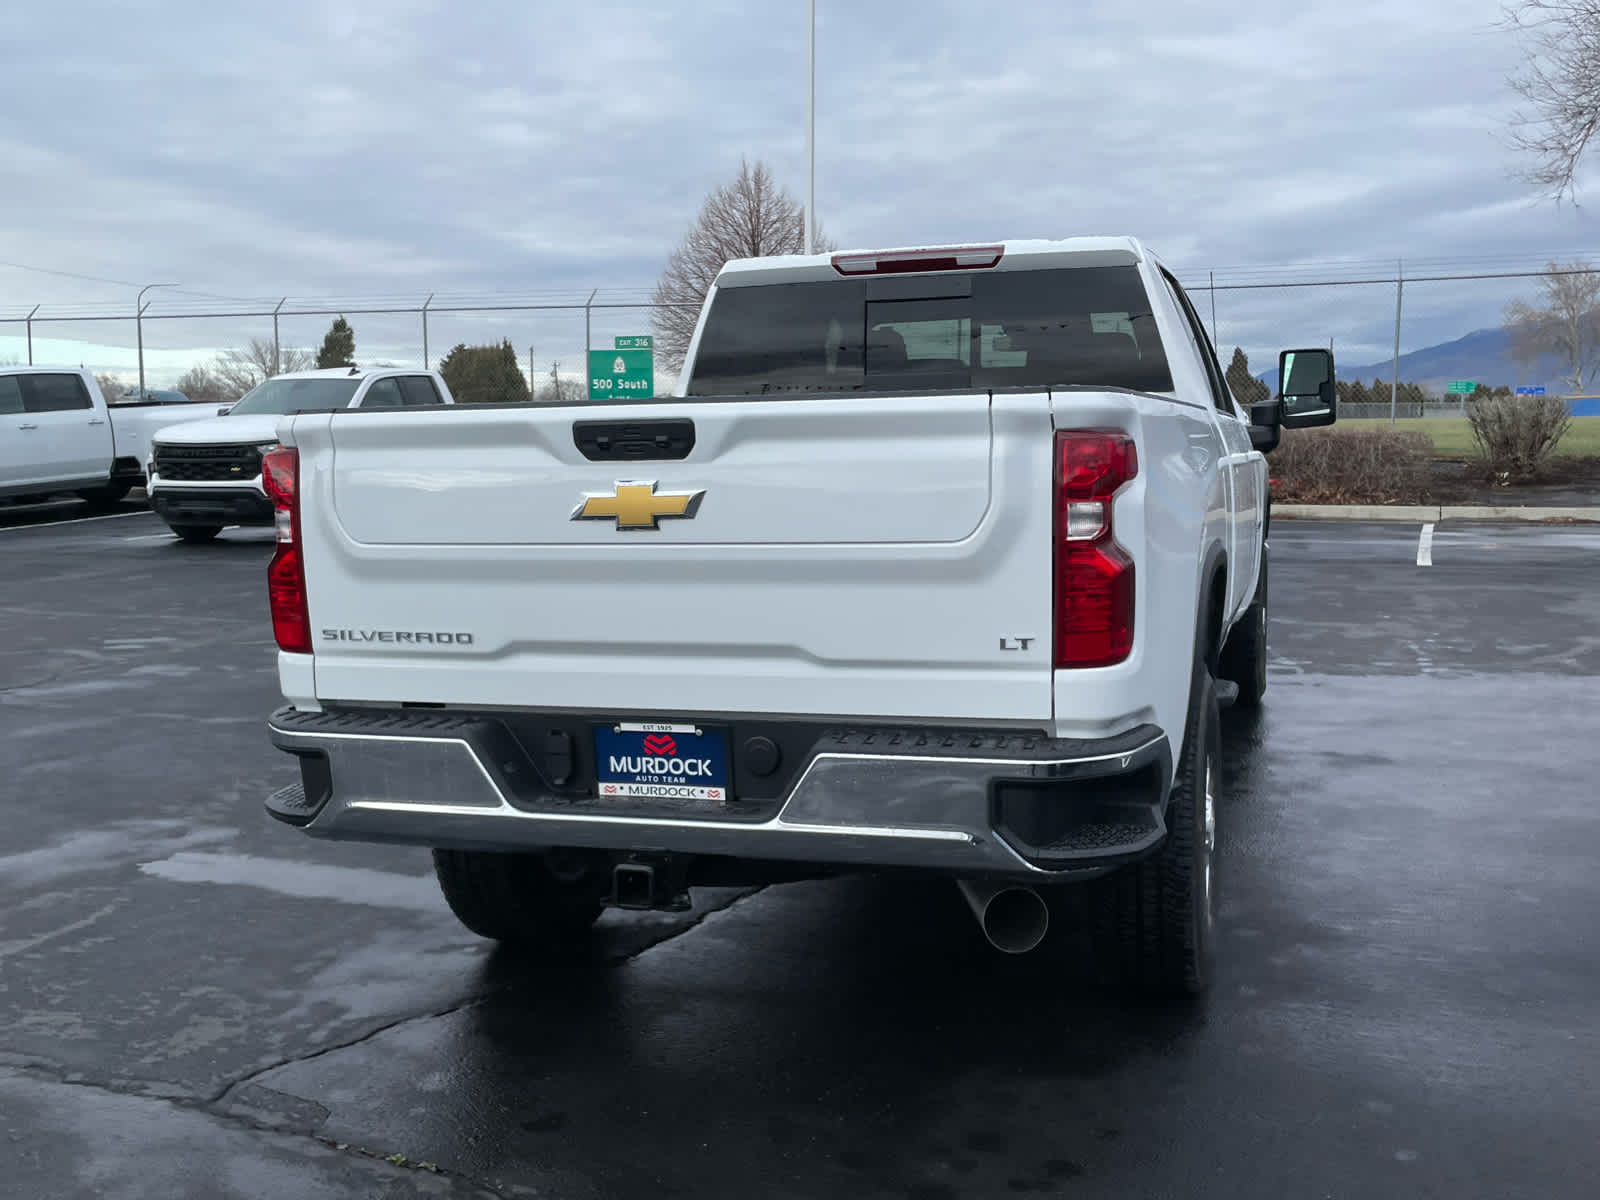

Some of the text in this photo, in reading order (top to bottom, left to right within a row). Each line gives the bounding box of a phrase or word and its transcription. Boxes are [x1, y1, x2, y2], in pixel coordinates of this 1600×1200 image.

[635, 338, 648, 346] 316
[592, 378, 648, 389] 500 South
[322, 629, 474, 644] SILVERADO
[999, 637, 1035, 651] LT
[609, 755, 712, 776] MURDOCK
[635, 775, 686, 784] AUTO TEAM
[628, 785, 696, 798] MURDOCK
